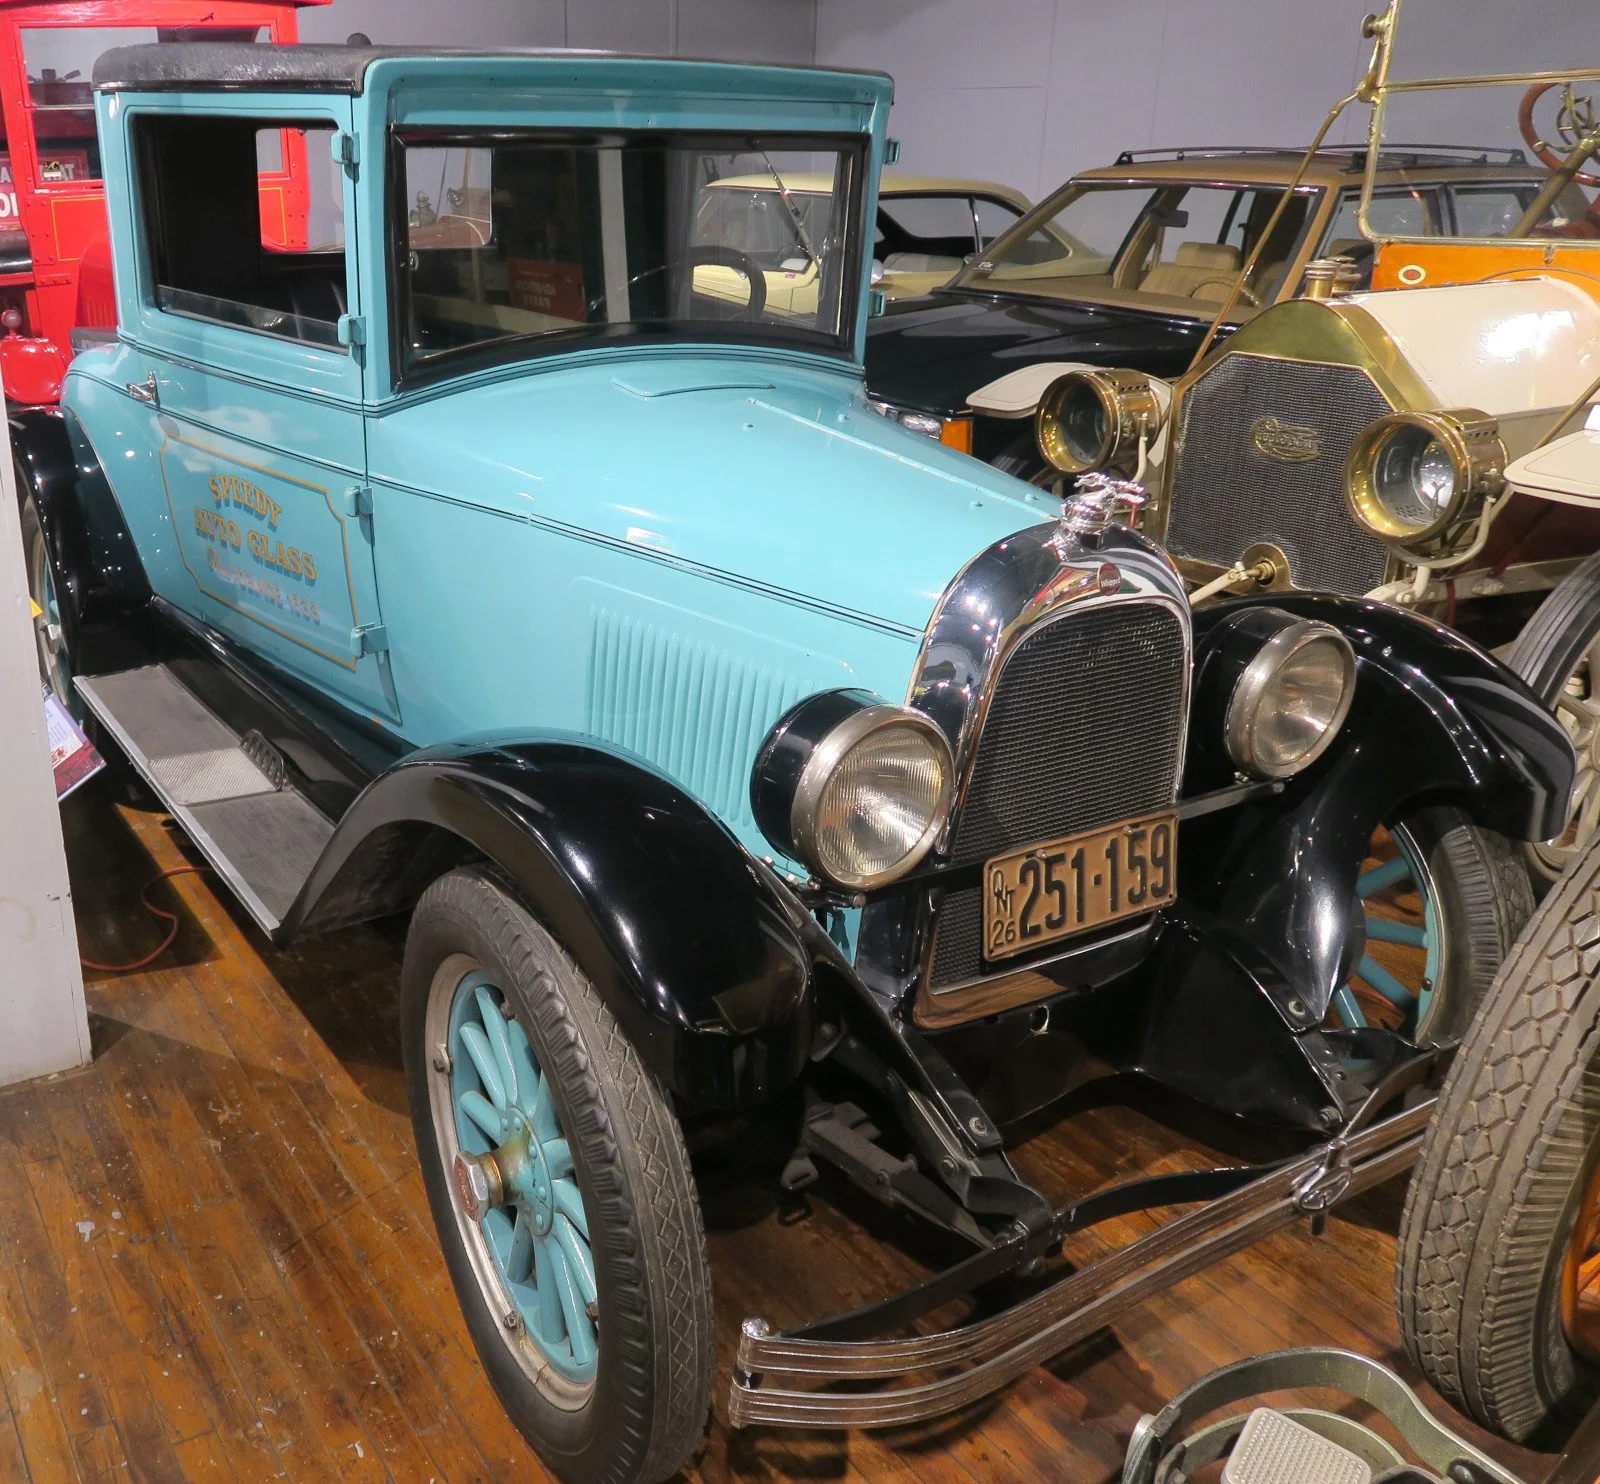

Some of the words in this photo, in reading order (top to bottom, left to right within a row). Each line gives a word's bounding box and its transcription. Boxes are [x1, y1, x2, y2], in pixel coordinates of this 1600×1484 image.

[208, 474, 283, 530] SPEEDY
[194, 505, 242, 551] AUTO
[248, 529, 318, 584] GLASS
[992, 919, 1016, 947] 26
